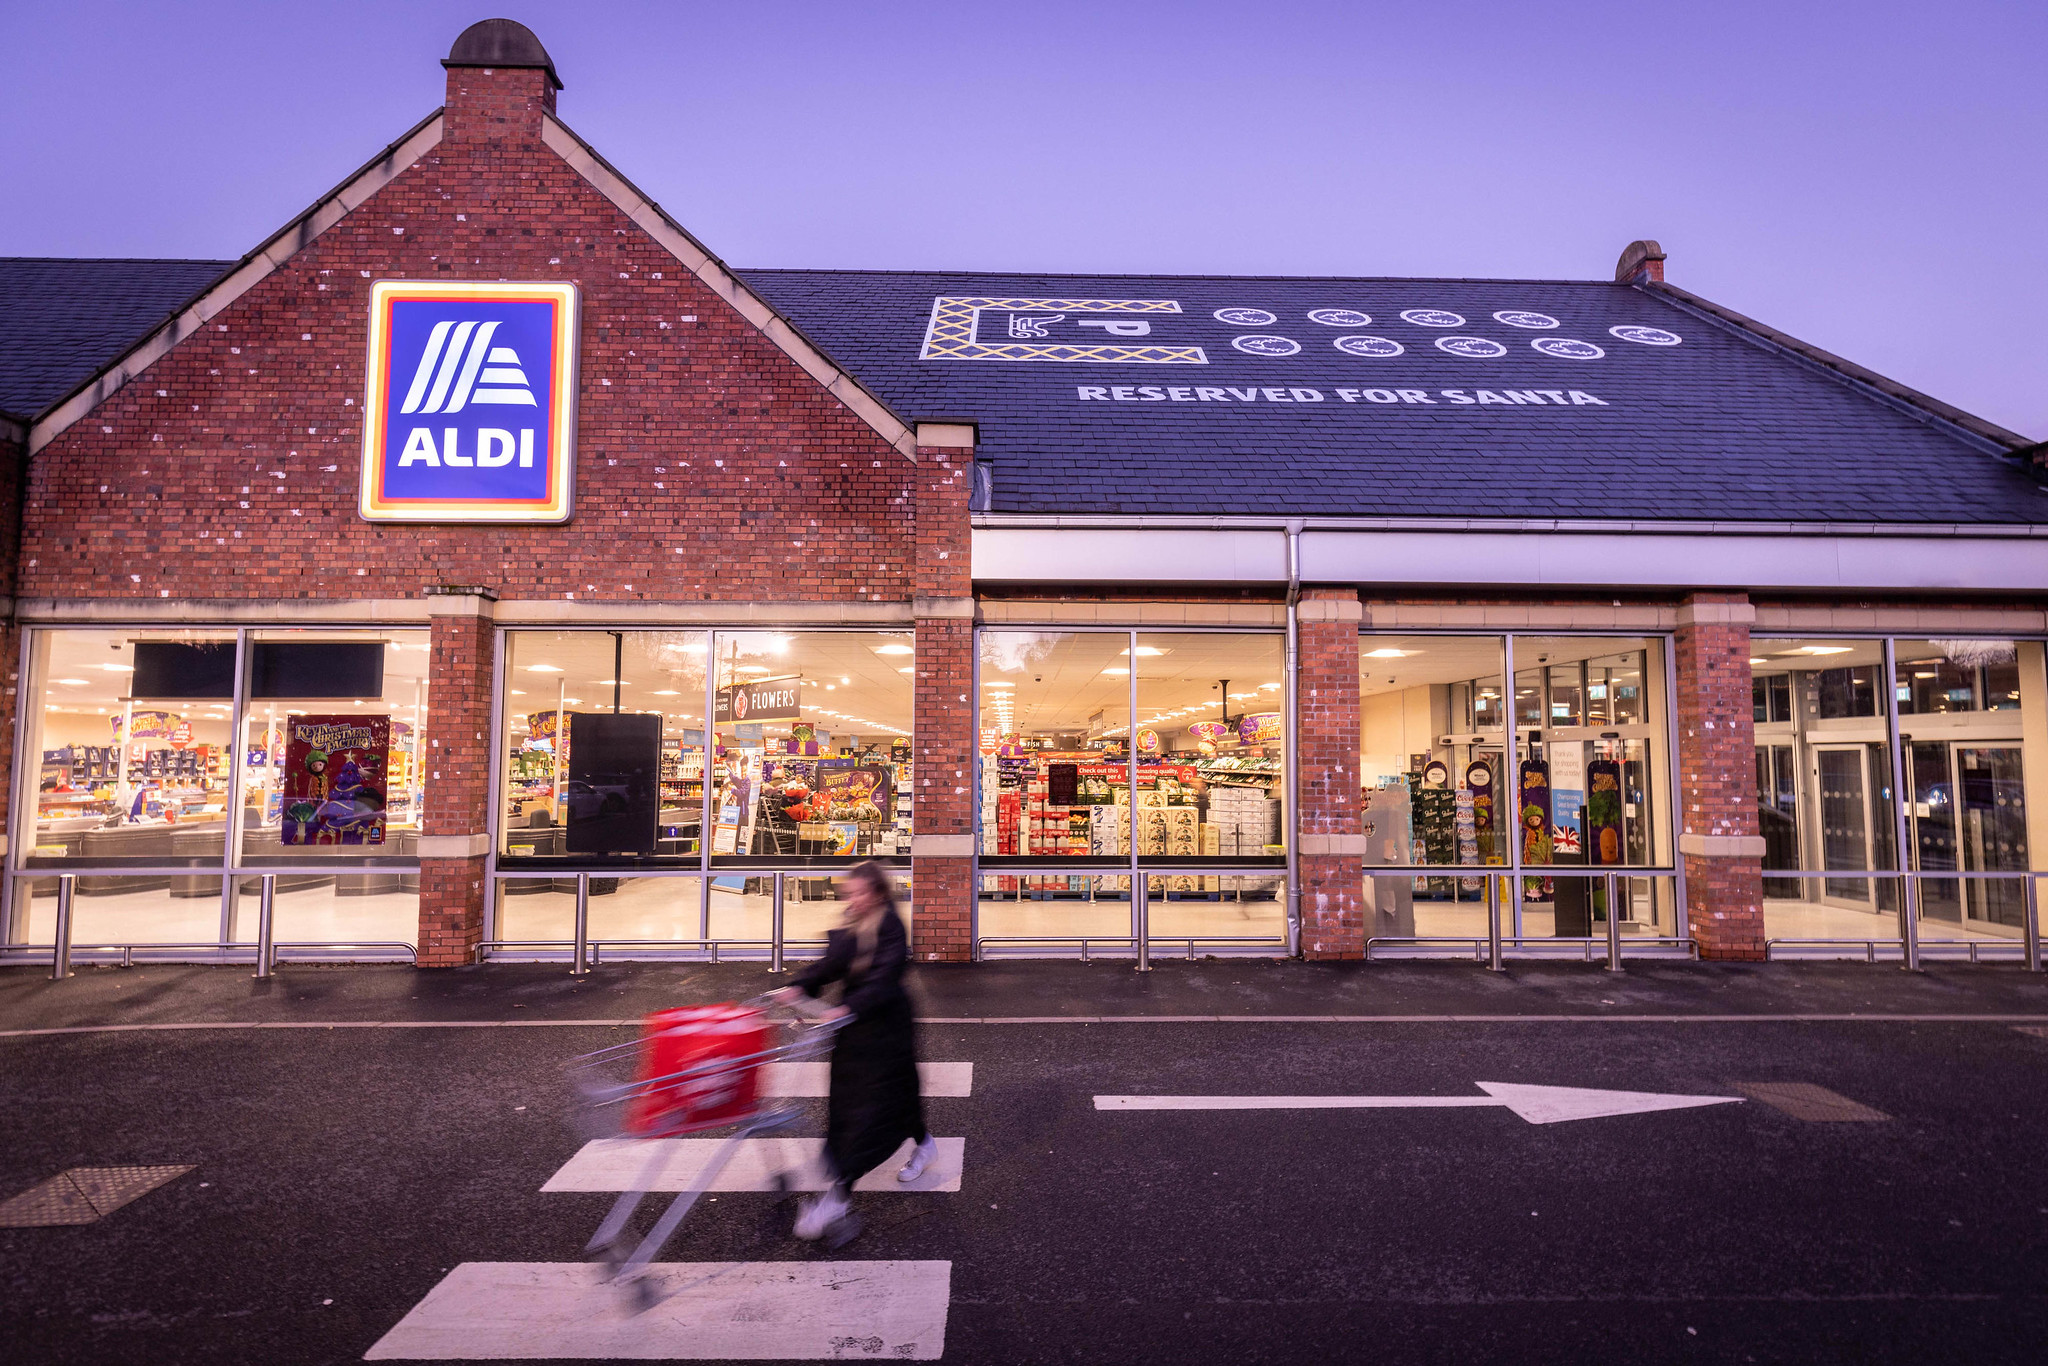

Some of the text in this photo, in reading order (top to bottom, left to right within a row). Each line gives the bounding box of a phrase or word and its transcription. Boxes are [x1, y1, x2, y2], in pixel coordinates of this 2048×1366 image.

[1078, 320, 1151, 336] P
[1077, 386, 1610, 405] RESERVED FOR SANTA
[397, 427, 535, 468] ALDI
[751, 689, 795, 710] FLOWERS
[297, 725, 328, 741] KEVIN
[311, 728, 370, 748] CHRISTMAS
[326, 737, 370, 753] FACTORY
[1136, 768, 1158, 776] Amazing
